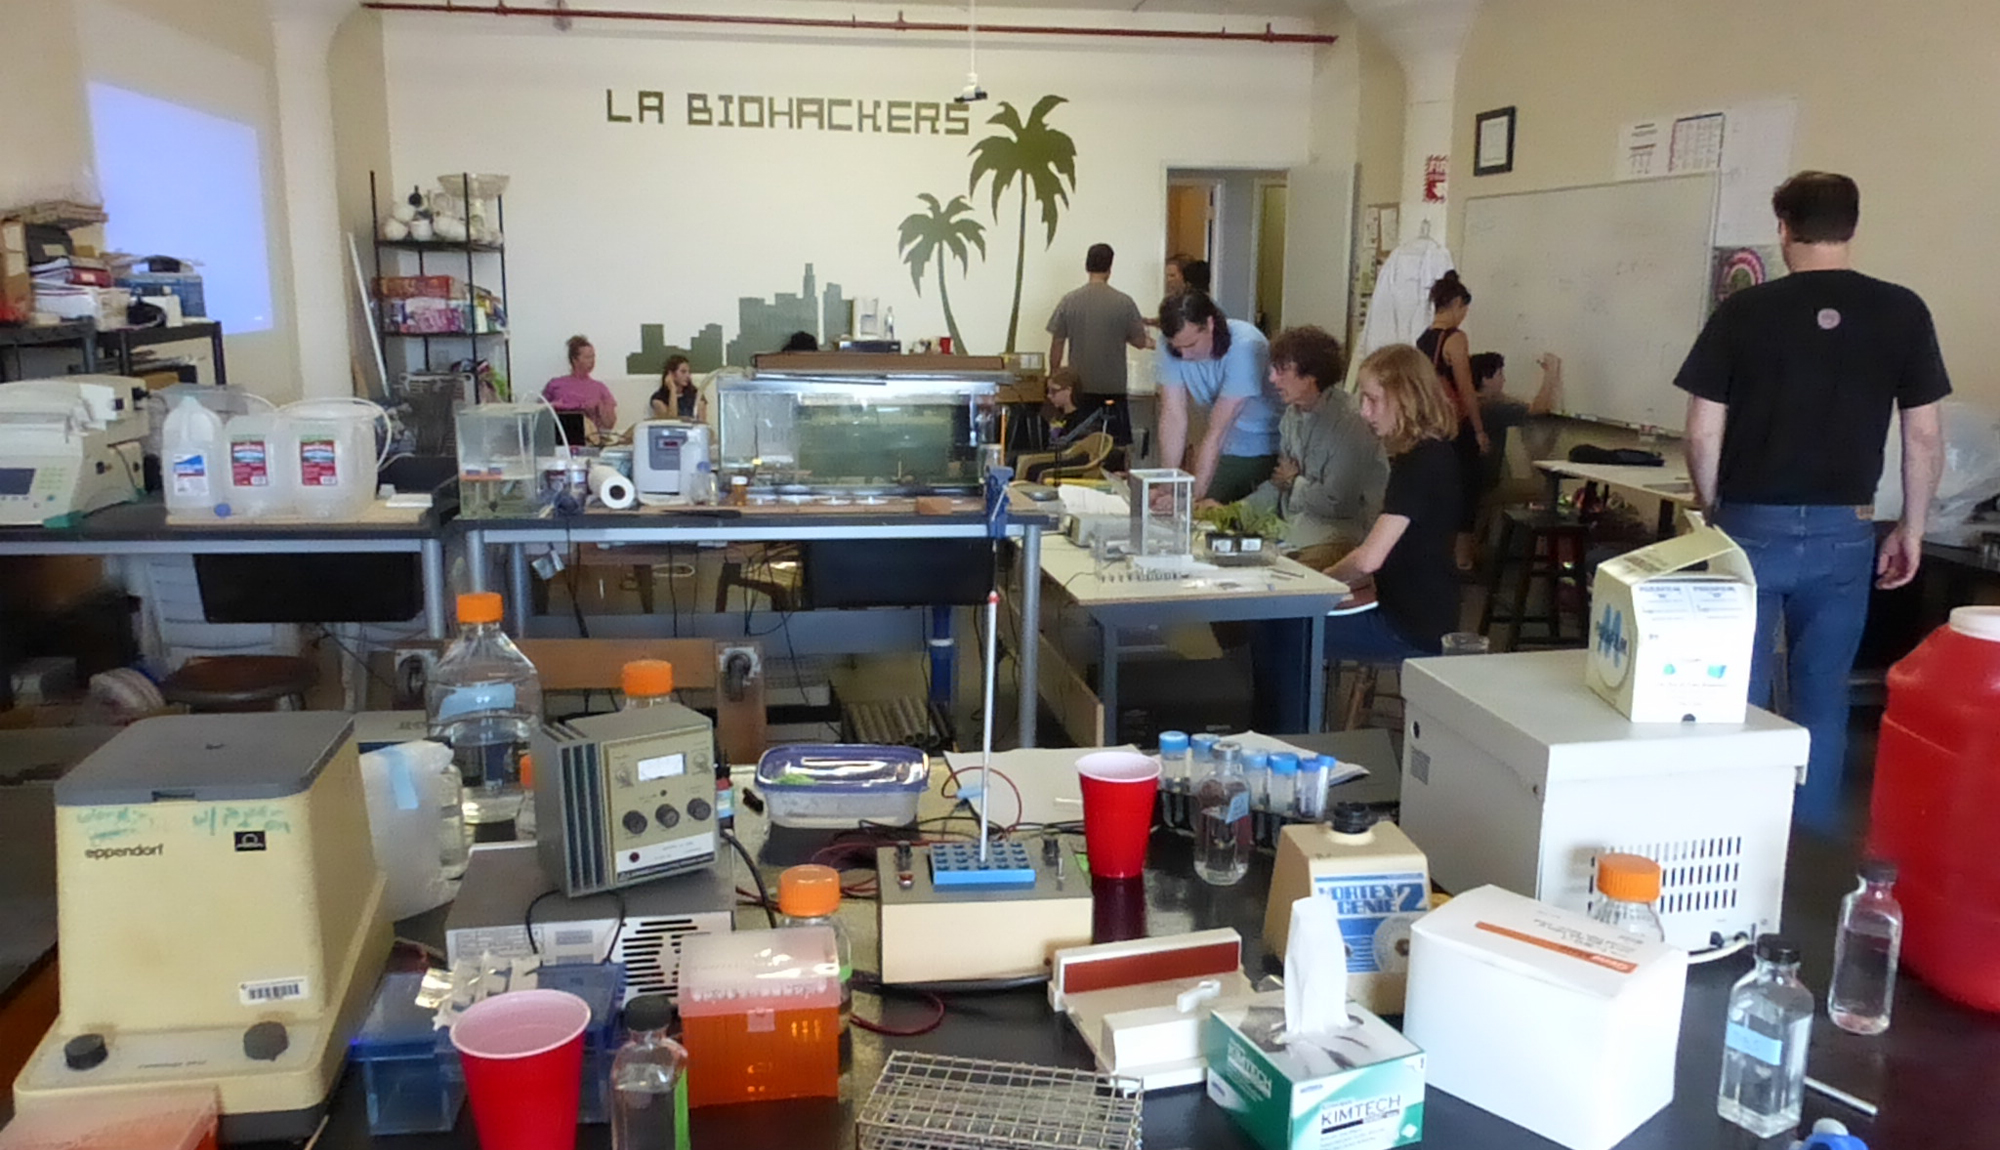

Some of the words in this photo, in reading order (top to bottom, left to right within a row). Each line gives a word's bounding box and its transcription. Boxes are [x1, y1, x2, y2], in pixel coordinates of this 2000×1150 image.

[606, 88, 664, 124] LA
[687, 92, 970, 136] BIOHACKERS
[85, 843, 164, 860] eppendorf
[1336, 898, 1398, 915] GENIE
[1397, 882, 1428, 912] 2
[1321, 1093, 1401, 1126] KIMTECH
